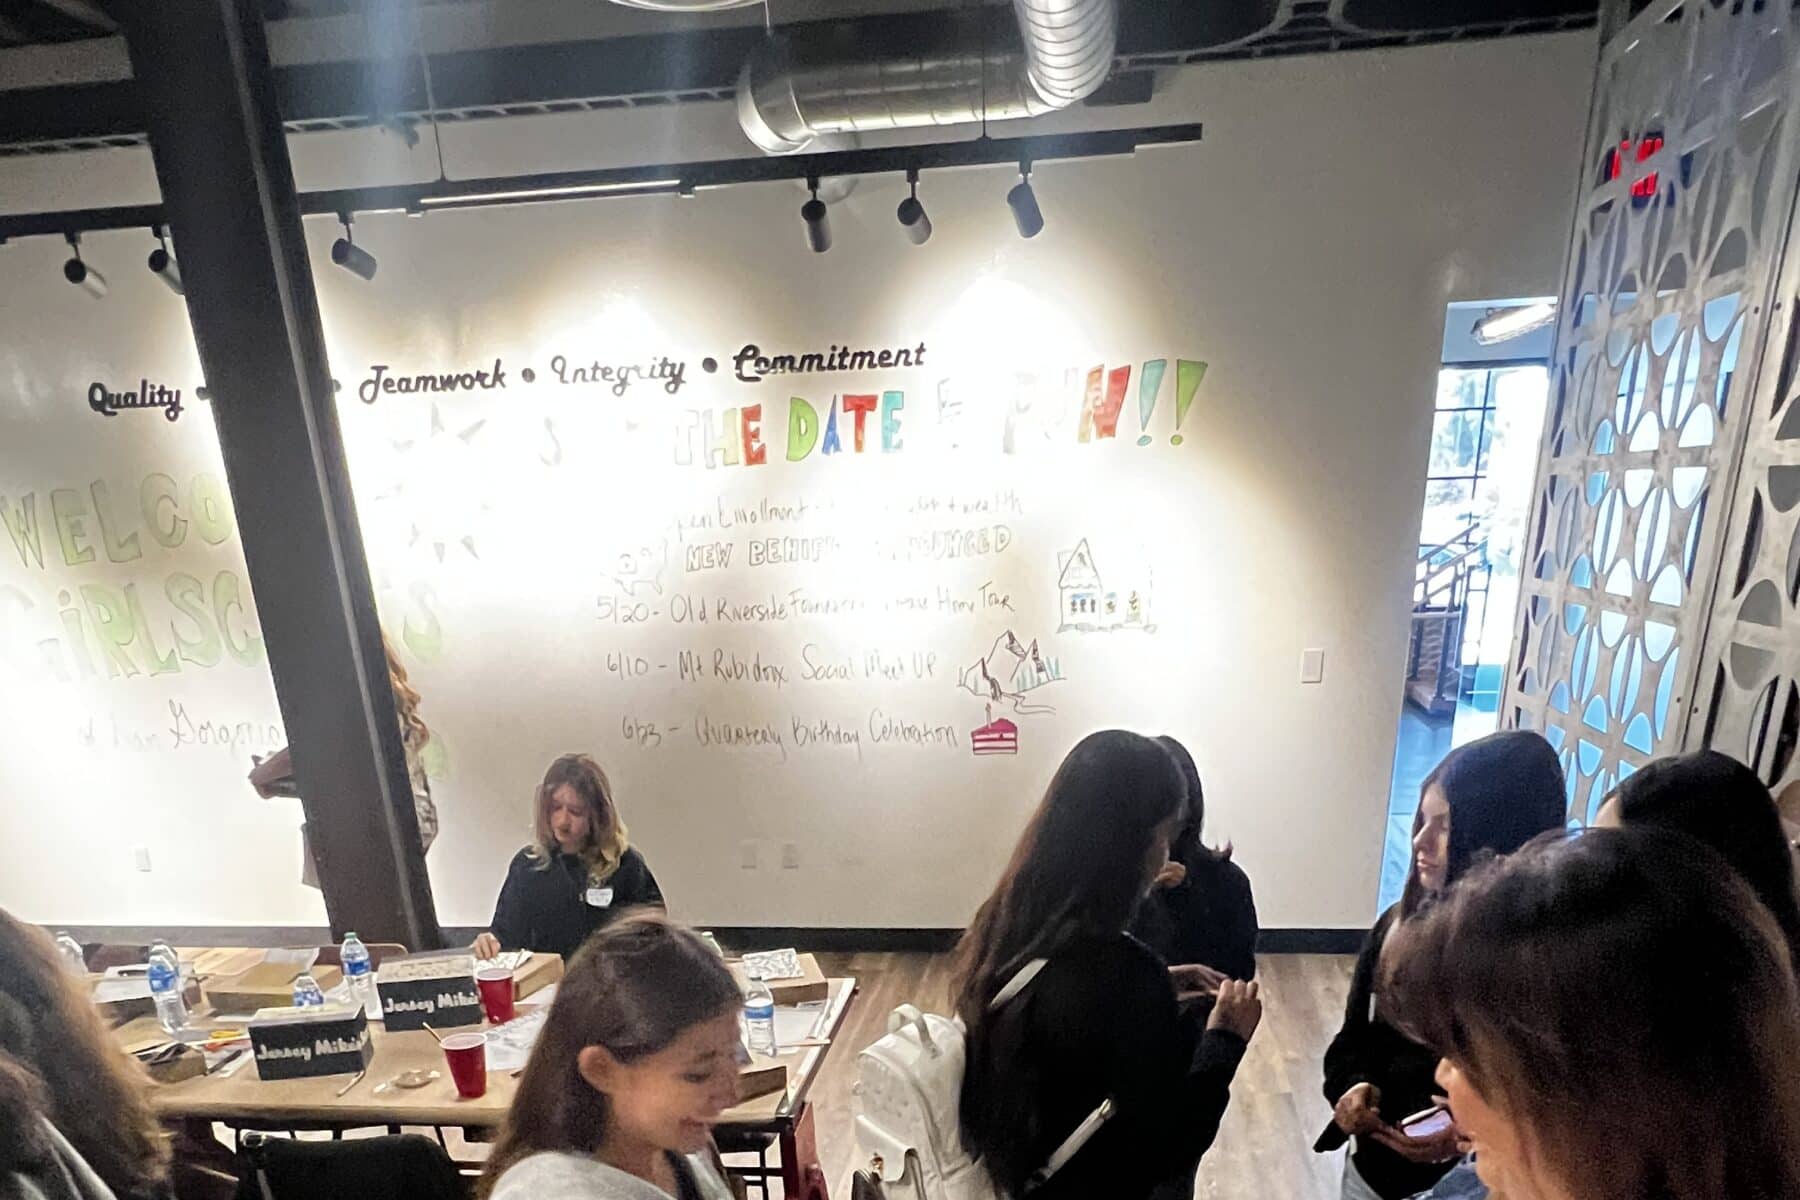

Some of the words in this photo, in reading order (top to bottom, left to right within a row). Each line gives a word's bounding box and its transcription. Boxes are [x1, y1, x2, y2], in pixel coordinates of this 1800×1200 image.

[89, 379, 184, 421] Quality
[359, 359, 506, 404] Teamwork
[551, 354, 686, 396] Integrity
[733, 342, 926, 382] Commitment
[785, 390, 905, 462] DATE
[686, 542, 734, 572] NEW
[670, 593, 707, 624] Old
[716, 594, 788, 623] Riverside
[606, 651, 649, 681] 6/10
[801, 643, 853, 682] Social
[792, 715, 862, 761] Birthday
[869, 707, 959, 750] Celebration
